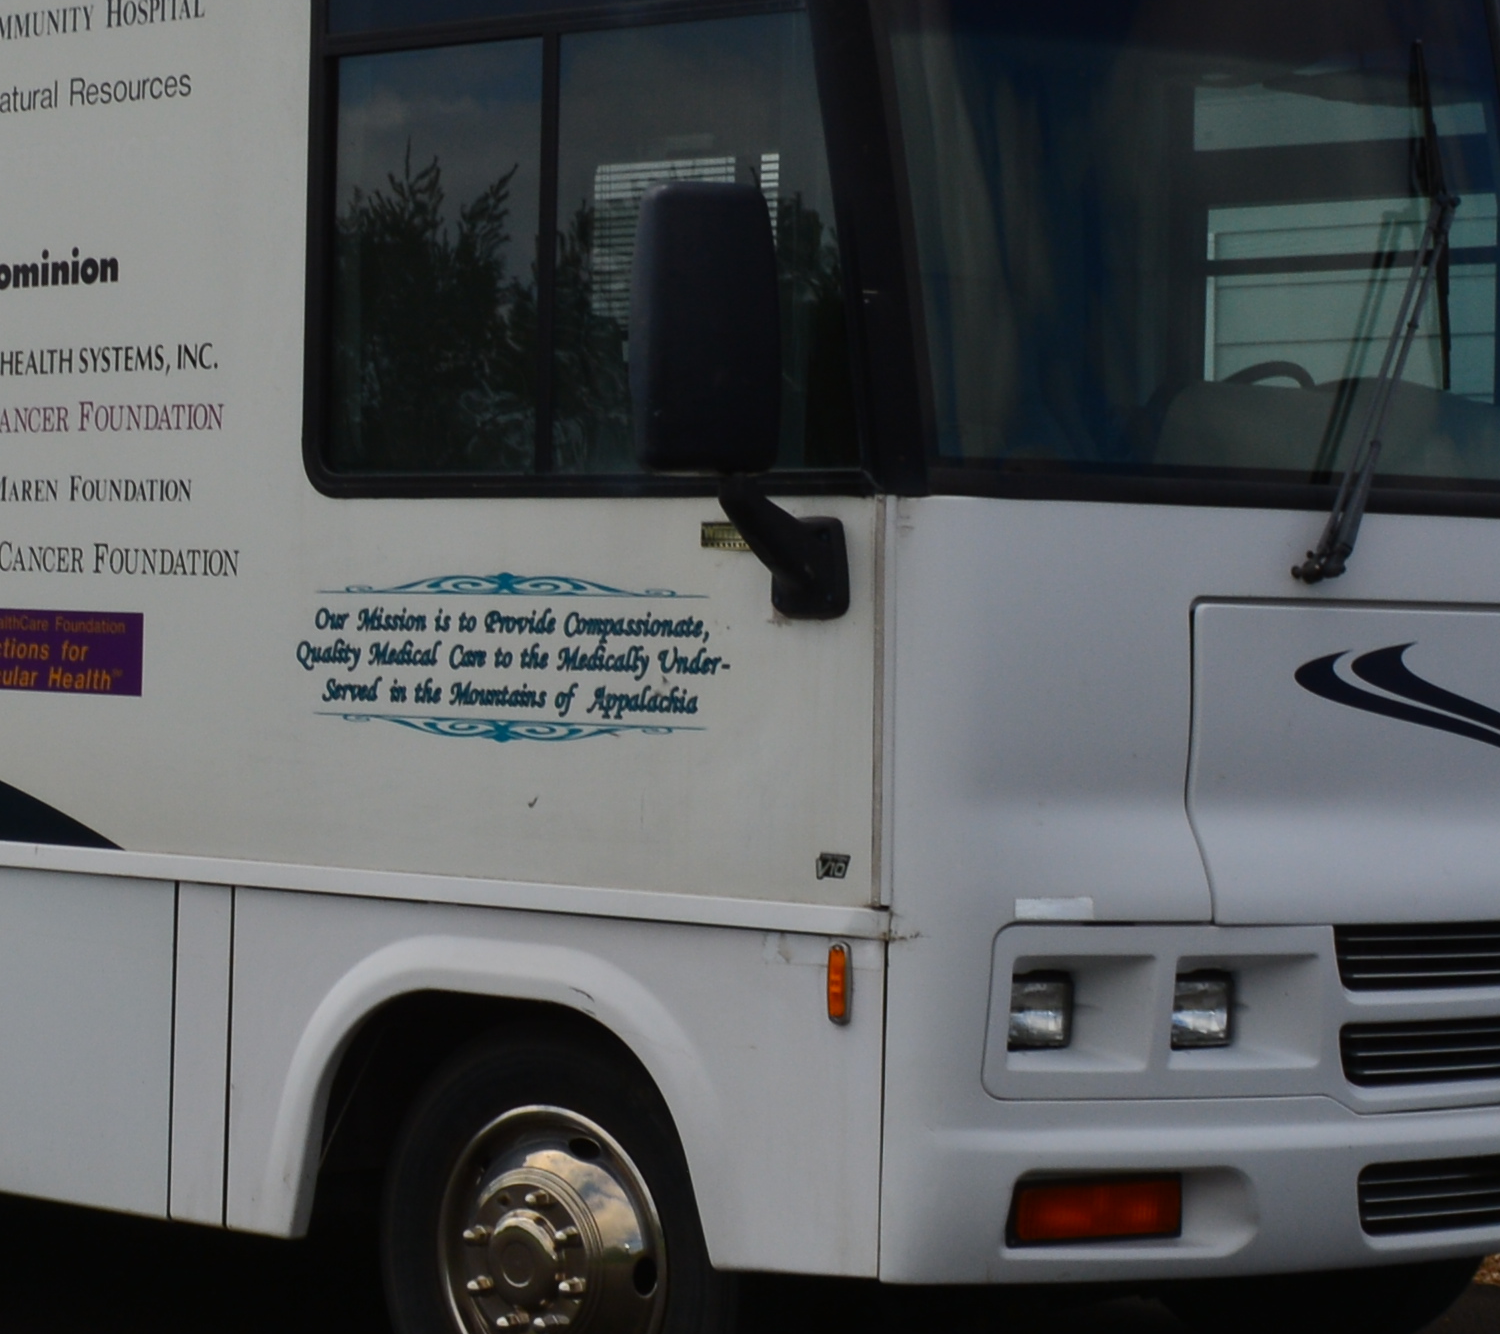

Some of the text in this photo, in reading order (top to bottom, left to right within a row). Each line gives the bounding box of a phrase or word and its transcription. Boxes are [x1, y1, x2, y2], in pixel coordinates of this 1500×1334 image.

[69, 72, 193, 108] Resources
[0, 348, 73, 377] HEALTH
[78, 344, 172, 377] SYSTEMS,
[177, 343, 219, 371] INC.
[78, 400, 225, 433] FOUNDATION
[69, 475, 192, 503] FOUNDATION
[93, 543, 240, 577] FOUNDATION
[55, 616, 126, 634] Foundation
[315, 608, 710, 644] Our Mission is to Provide Compassionate,
[61, 640, 88, 662] for
[296, 641, 730, 677] Quality Medical Care to the Medically Under-
[322, 676, 698, 720] Served in the Mountains of Appalachia
[816, 858, 846, 880] V10
